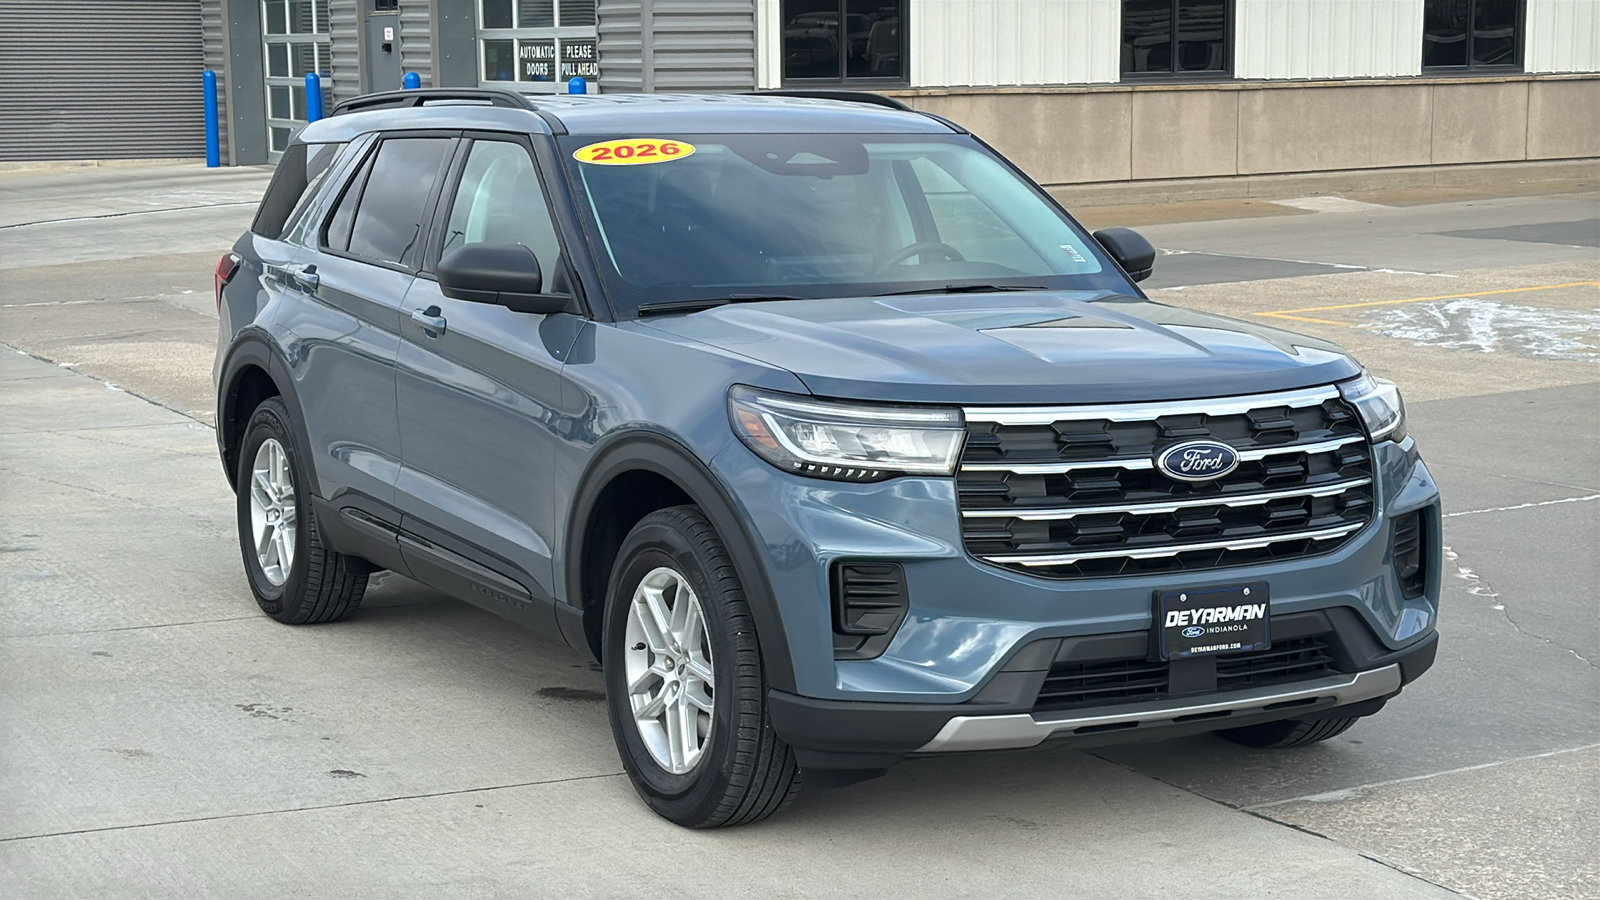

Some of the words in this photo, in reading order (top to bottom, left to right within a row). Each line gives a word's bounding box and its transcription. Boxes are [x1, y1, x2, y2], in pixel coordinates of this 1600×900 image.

[520, 45, 555, 58] AUTOMATIC
[566, 45, 592, 58] PLEASE
[526, 62, 549, 75] DOORS
[561, 62, 577, 75] PULL
[577, 62, 598, 75] AHEAD
[591, 143, 680, 161] 2026
[1180, 449, 1223, 472] Ford
[1165, 603, 1266, 628] DEYARMAN
[1206, 624, 1248, 634] INDIANOLA
